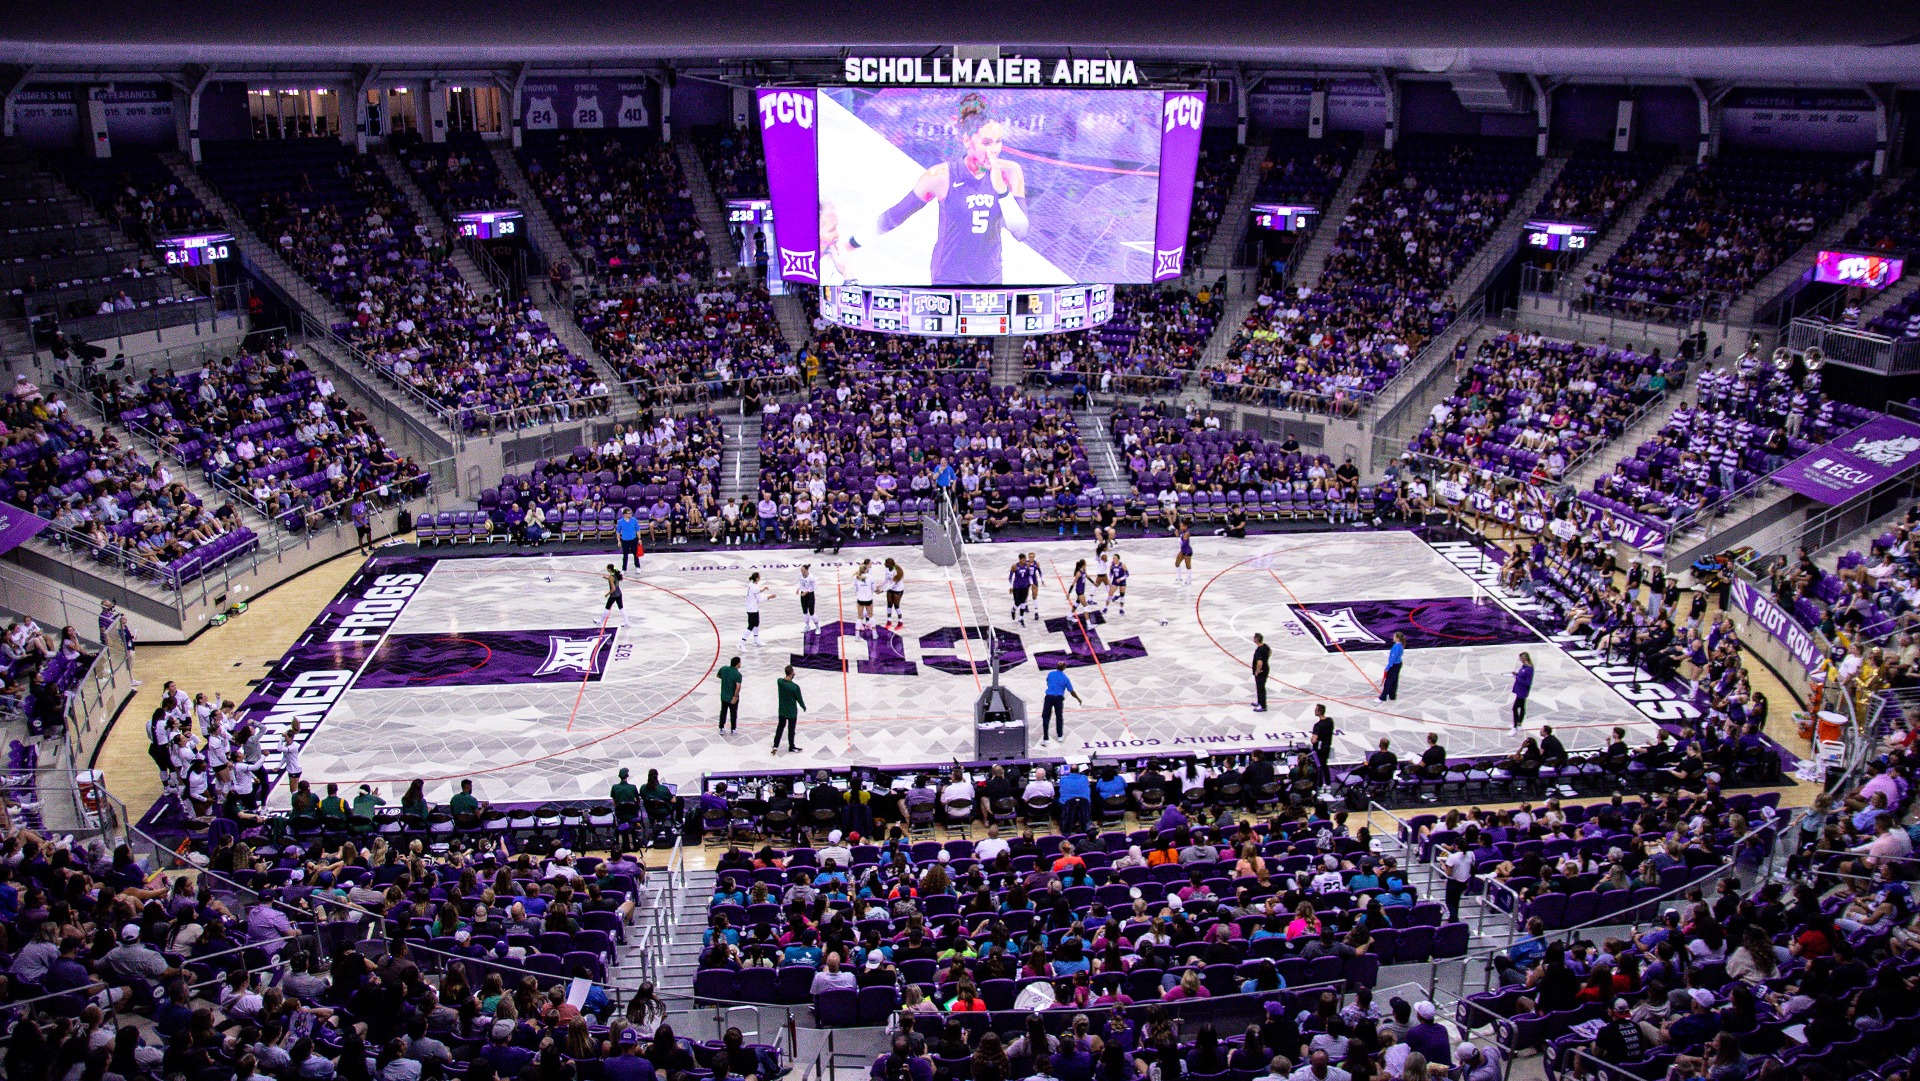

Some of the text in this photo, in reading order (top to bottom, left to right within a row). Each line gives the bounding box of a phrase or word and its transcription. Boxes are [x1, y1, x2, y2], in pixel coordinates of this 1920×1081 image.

[845, 57, 1139, 85] SCHOLLMAIER ARENA
[104, 107, 120, 116] 015
[532, 110, 551, 124] 24
[579, 109, 597, 123] 28
[624, 108, 642, 121] 40
[759, 91, 813, 129] TCU
[1164, 95, 1204, 133] TCU
[965, 194, 995, 209] TCU
[971, 210, 990, 233] 5
[207, 246, 229, 260] 3.0
[913, 295, 951, 315] TCU
[970, 293, 998, 306] 1:30
[924, 319, 939, 331] 21
[1027, 317, 1043, 330] 24
[1825, 463, 1874, 485] EECU
[1473, 493, 1487, 510] T
[1498, 502, 1509, 519] C
[327, 573, 425, 642] FROGS
[1752, 596, 1815, 666] RIOT ROW
[614, 643, 634, 662] 1873
[790, 610, 1148, 676] TCU
[1081, 728, 1346, 750] WLSH FAMILY COURT
[1323, 881, 1341, 894] 23
